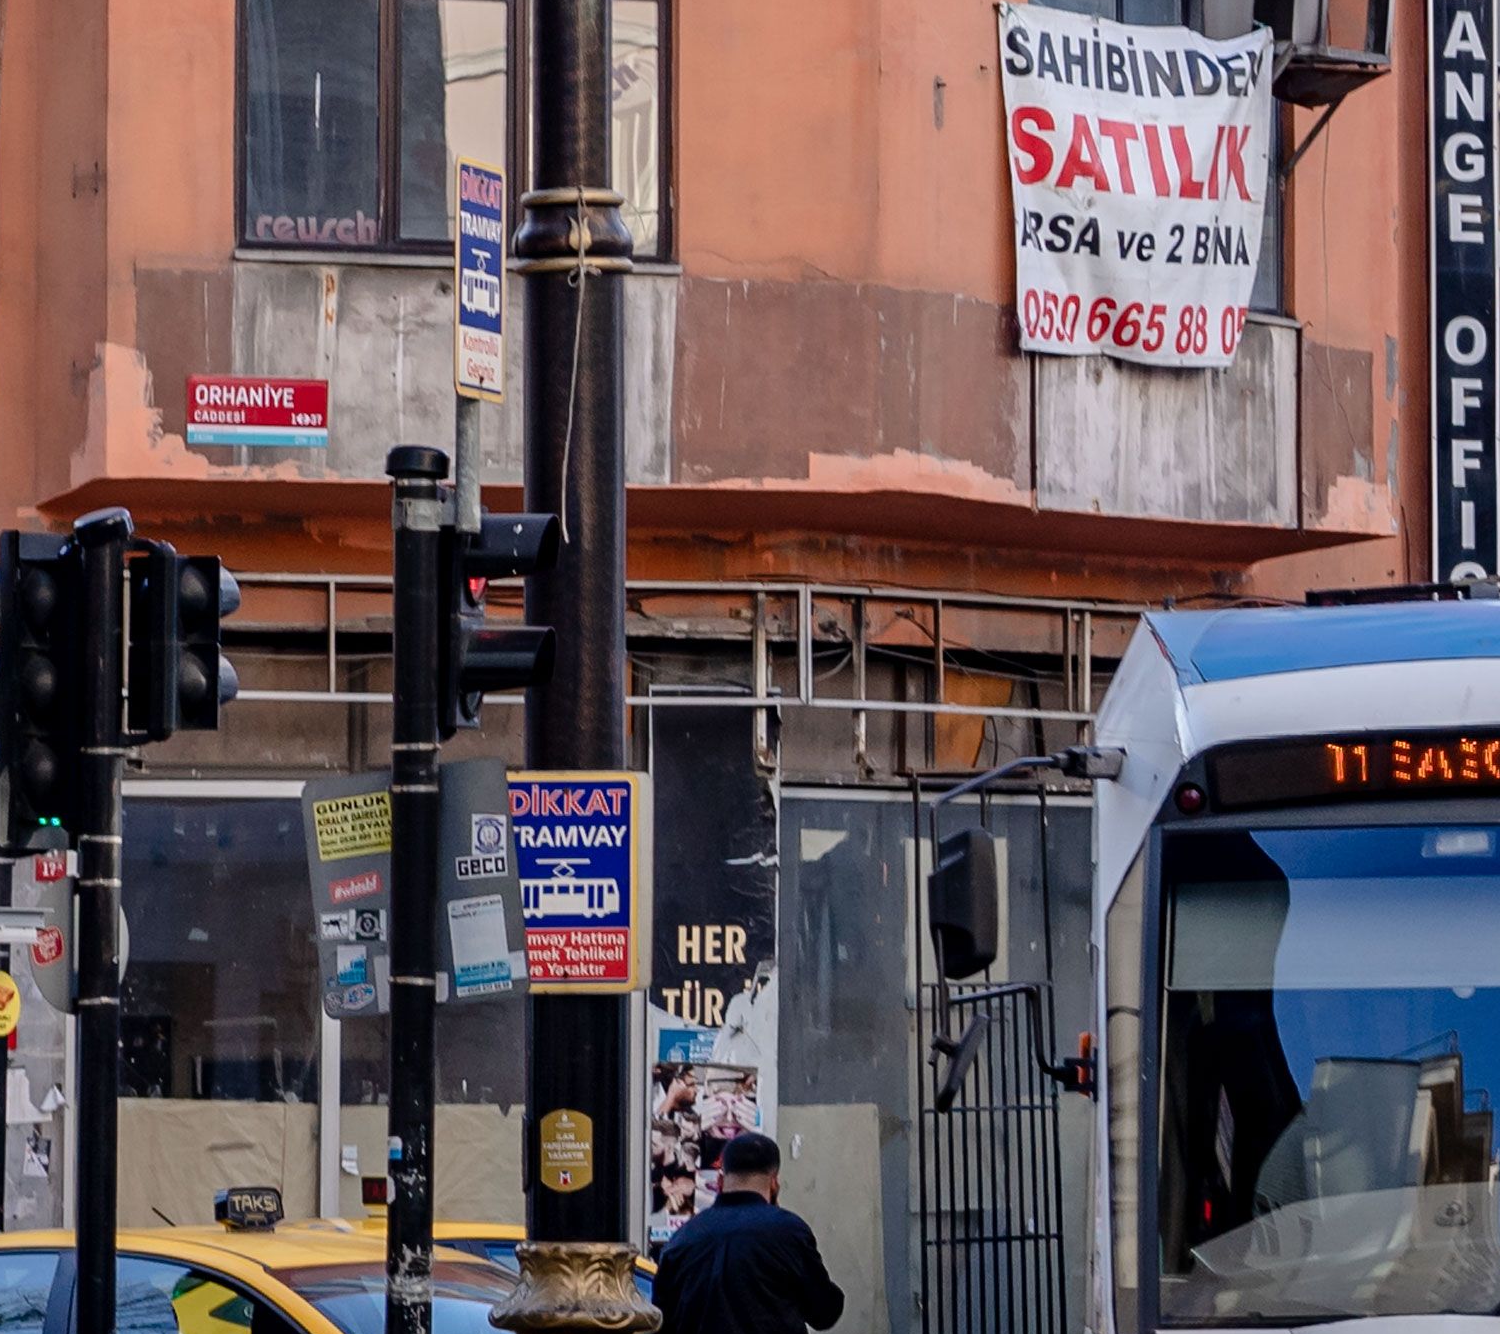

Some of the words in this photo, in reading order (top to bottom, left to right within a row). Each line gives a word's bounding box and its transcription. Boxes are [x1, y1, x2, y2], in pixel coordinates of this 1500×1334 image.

[1011, 106, 1253, 201] SATILIK
[461, 167, 501, 207] DİKKAT
[255, 211, 378, 246] reusch
[461, 210, 501, 244] TRAMVAY
[1117, 228, 1156, 262] ve
[1166, 224, 1185, 264] 2
[1087, 297, 1167, 354] 665
[1176, 304, 1208, 355] 88
[195, 382, 295, 409] ORHANİYE
[194, 410, 246, 425] CADDESİ
[1442, 314, 1490, 582] OFFI
[316, 796, 387, 815] GÜNLÜK
[509, 783, 628, 817] DİKKAT
[564, 947, 624, 962] Tehlikeli
[571, 930, 626, 946] Hattına
[677, 925, 748, 965] HER
[545, 962, 607, 977] Yasaktır
